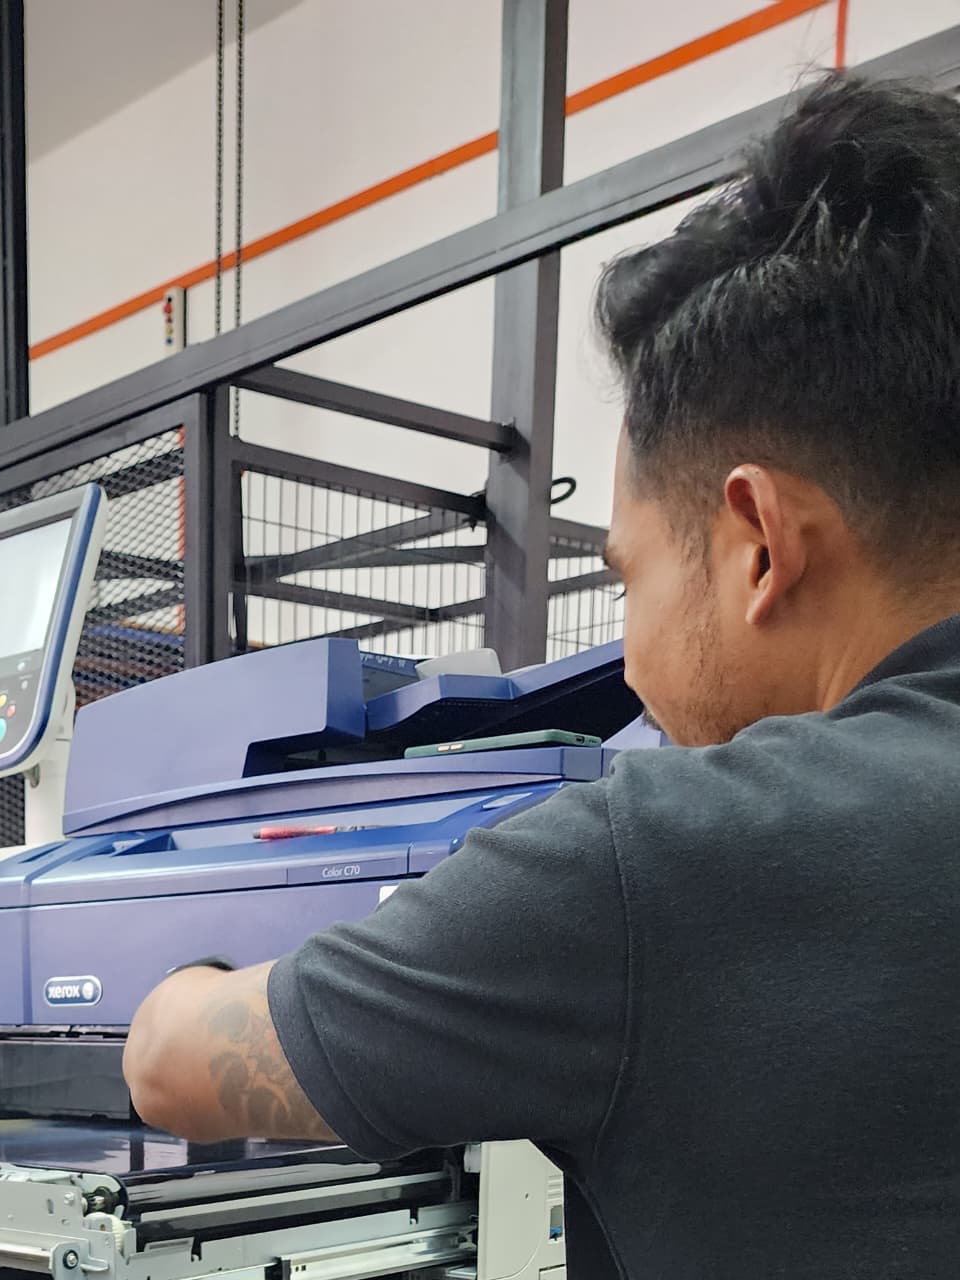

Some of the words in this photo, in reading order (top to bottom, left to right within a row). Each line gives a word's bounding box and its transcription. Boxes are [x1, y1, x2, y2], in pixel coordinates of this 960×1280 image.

[322, 867, 342, 878] Color
[344, 865, 360, 876] C70
[48, 985, 80, 999] xerox
